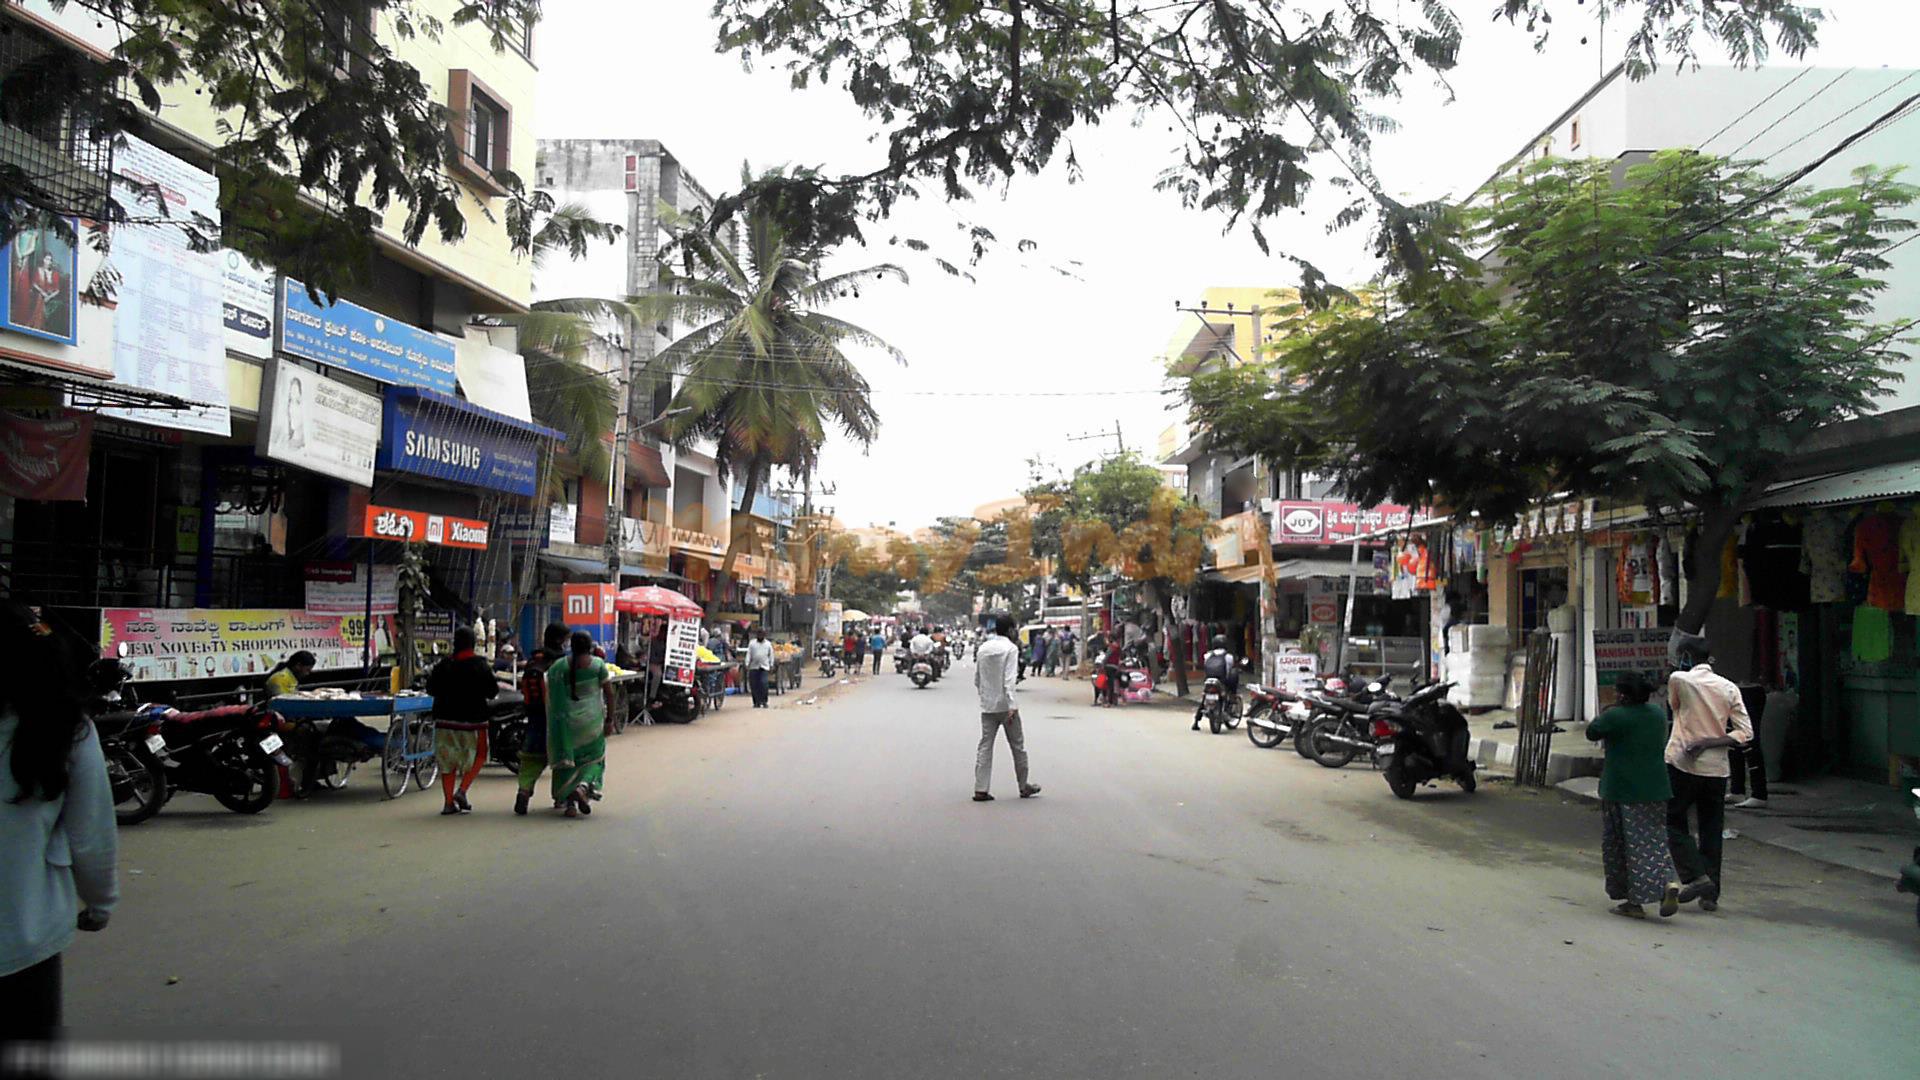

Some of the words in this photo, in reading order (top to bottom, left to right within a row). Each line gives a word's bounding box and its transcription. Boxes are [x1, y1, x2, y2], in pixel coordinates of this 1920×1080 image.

[405, 430, 480, 470] SAMSUNG
[1290, 519, 1313, 528] JOY
[452, 521, 487, 545] Xiaomi
[161, 640, 228, 654] NOVELTY
[232, 638, 298, 651] SHOPPING
[1594, 646, 1636, 658] MANISHA
